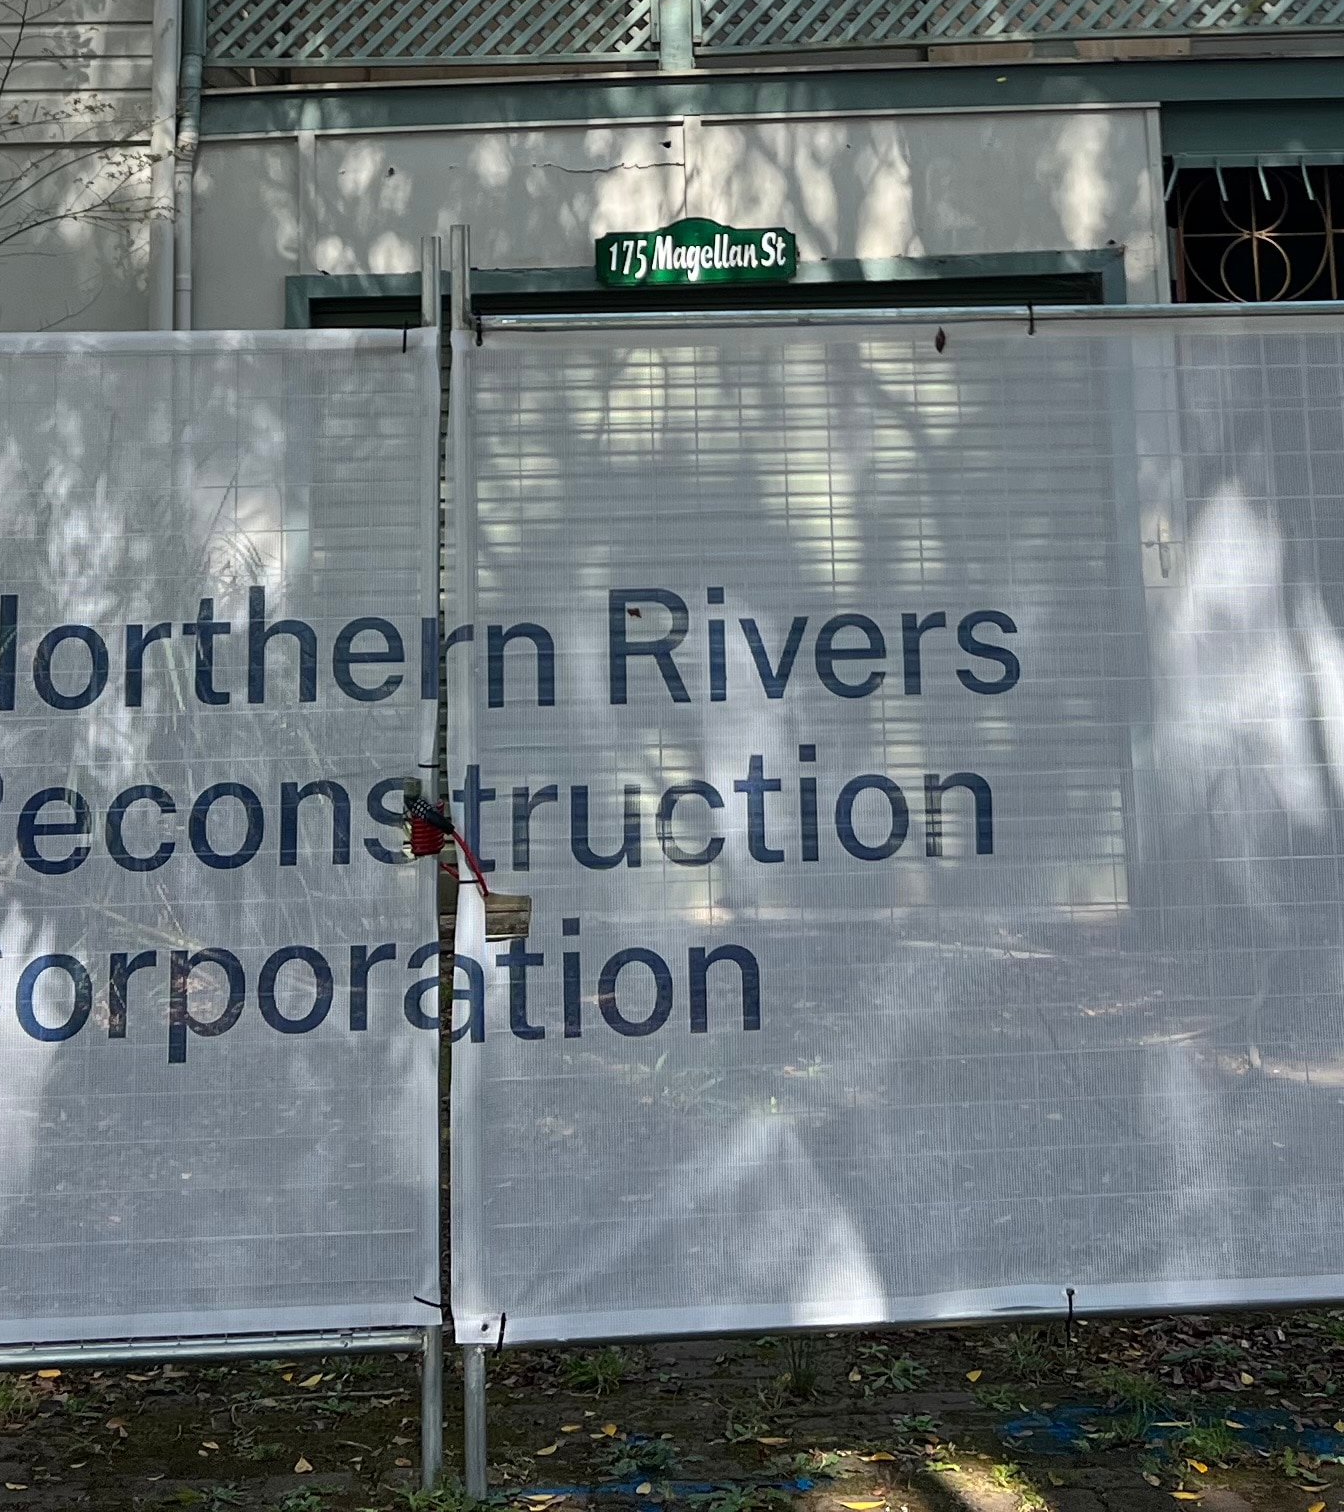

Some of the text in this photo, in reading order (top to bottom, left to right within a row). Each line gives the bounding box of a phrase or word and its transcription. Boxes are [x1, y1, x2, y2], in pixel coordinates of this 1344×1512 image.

[609, 231, 787, 281] 175 Magellan St
[608, 585, 1022, 706] Rivers
